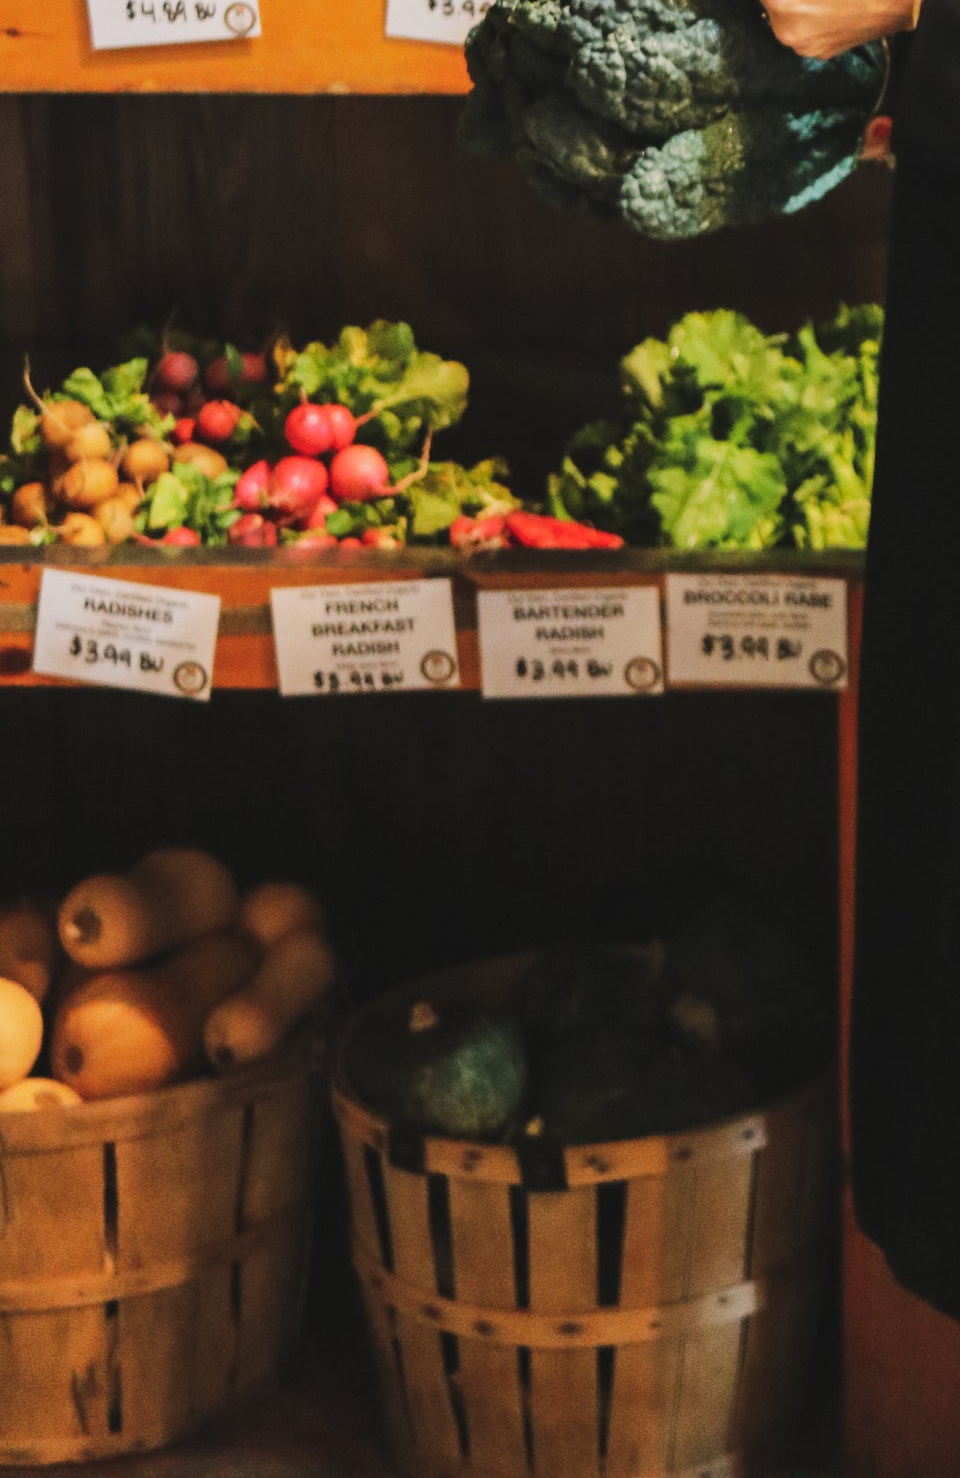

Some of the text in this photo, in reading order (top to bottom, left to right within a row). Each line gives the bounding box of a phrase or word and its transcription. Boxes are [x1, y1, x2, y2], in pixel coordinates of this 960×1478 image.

[84, 597, 174, 623] RADISHES
[325, 599, 399, 615] FRENCH
[512, 604, 625, 620] BARTENDER
[311, 618, 415, 637] BREAKFAST
[535, 627, 605, 641] RADISH
[332, 641, 400, 657] RADISH
